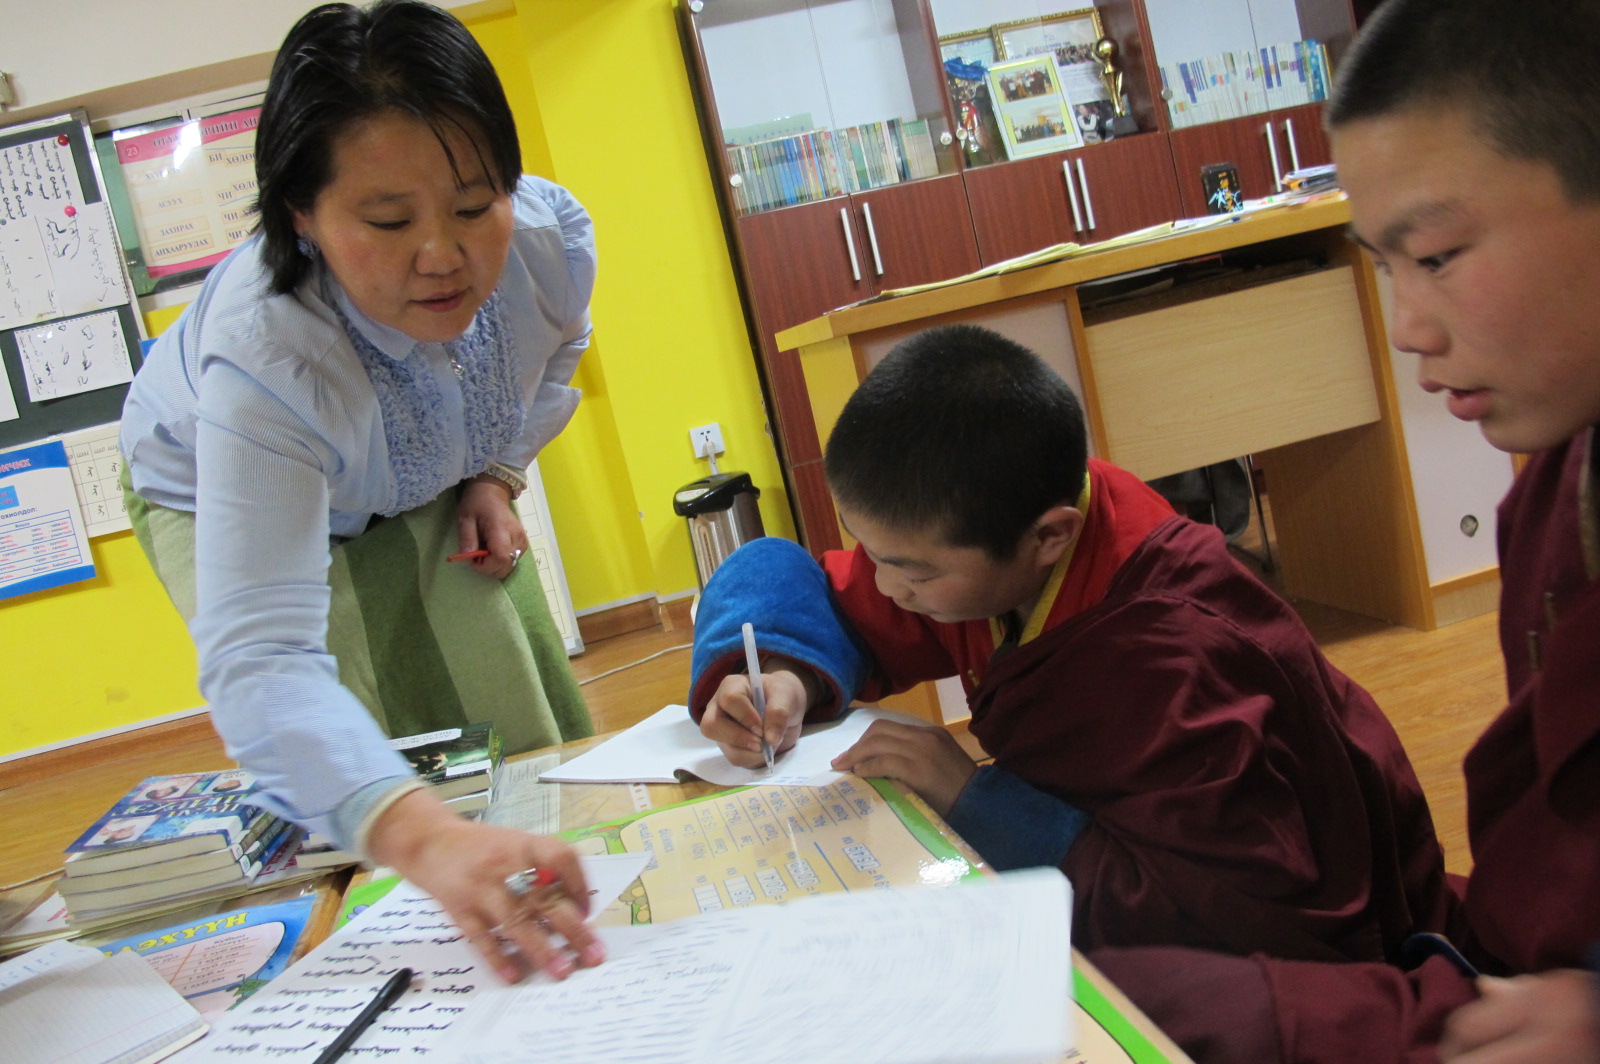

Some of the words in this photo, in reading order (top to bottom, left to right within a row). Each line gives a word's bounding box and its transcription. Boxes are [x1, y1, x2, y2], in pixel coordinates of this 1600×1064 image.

[127, 147, 139, 157] 23
[208, 152, 222, 163] БИ
[218, 191, 232, 200] ЧИ
[224, 212, 238, 221] ЧИ
[161, 223, 194, 236] ЗАХИРАХ
[228, 230, 243, 240] ЧИ
[155, 239, 209, 257] АНХААРУУЛАХ
